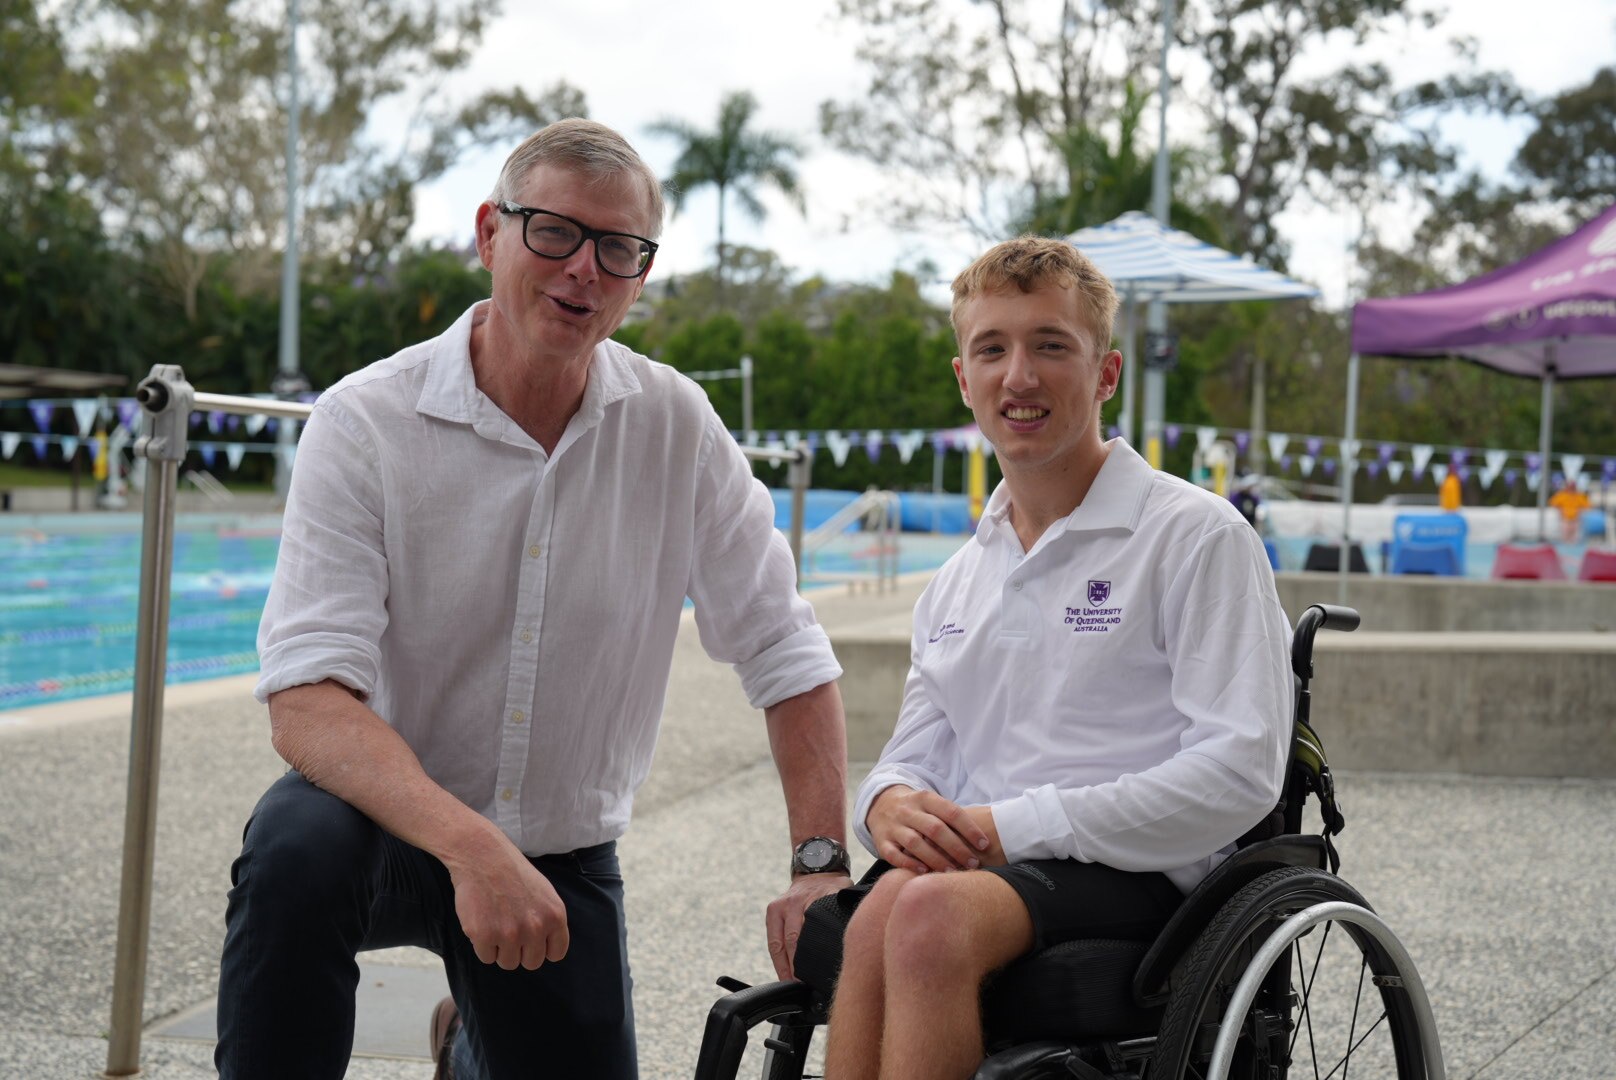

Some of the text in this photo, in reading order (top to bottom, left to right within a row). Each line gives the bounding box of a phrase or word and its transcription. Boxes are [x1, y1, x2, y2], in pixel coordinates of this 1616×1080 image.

[1066, 607, 1122, 616] THE UNIVERSITY
[1064, 616, 1121, 625] OF QUEENSLAND
